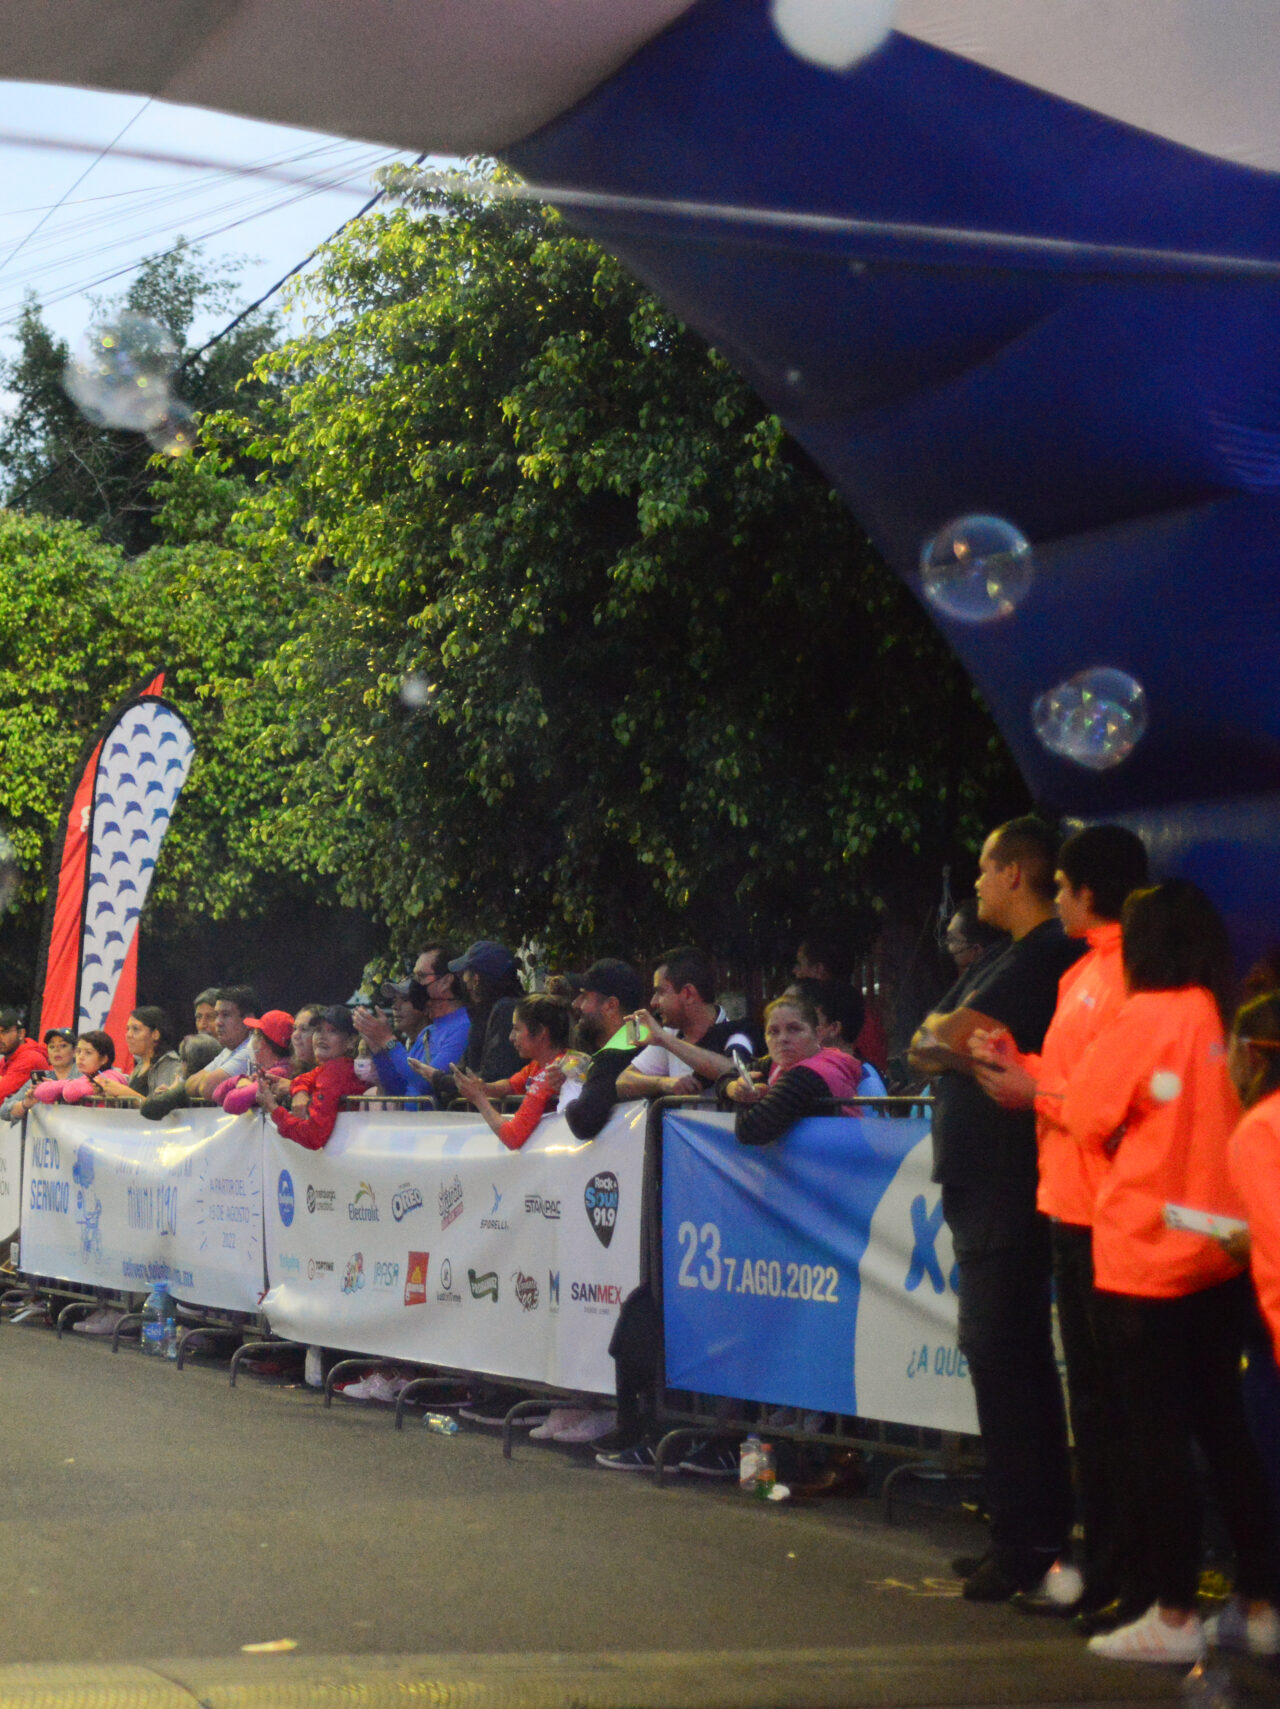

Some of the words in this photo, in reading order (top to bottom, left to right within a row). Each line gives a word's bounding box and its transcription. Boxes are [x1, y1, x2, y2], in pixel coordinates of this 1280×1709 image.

[32, 1137, 60, 1169] NUEVO
[30, 1179, 69, 1214] SERVICIO
[348, 1202, 380, 1221] Electrolit
[392, 1188, 423, 1222] OREO
[678, 1221, 721, 1291] 23
[724, 1258, 839, 1303] 7.AGO.2022
[571, 1282, 622, 1304] SANMEX
